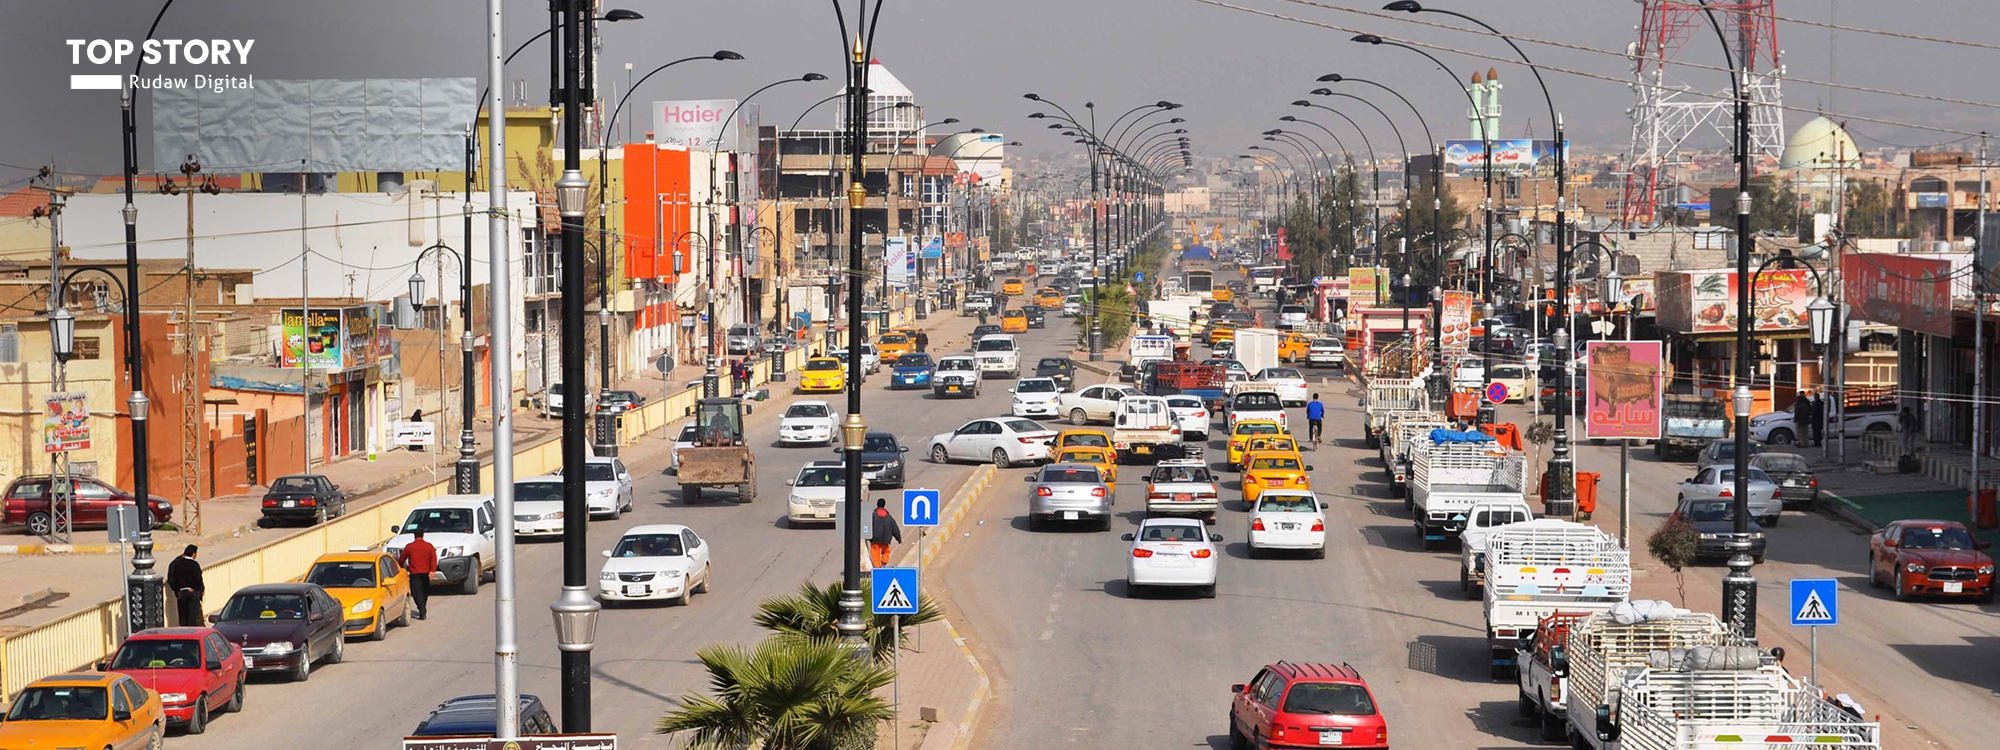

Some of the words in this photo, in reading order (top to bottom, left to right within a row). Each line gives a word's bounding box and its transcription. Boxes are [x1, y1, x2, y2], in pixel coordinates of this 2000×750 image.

[664, 105, 723, 123] Haier
[689, 138, 701, 146] 12
[1495, 151, 1518, 162] صلاح
